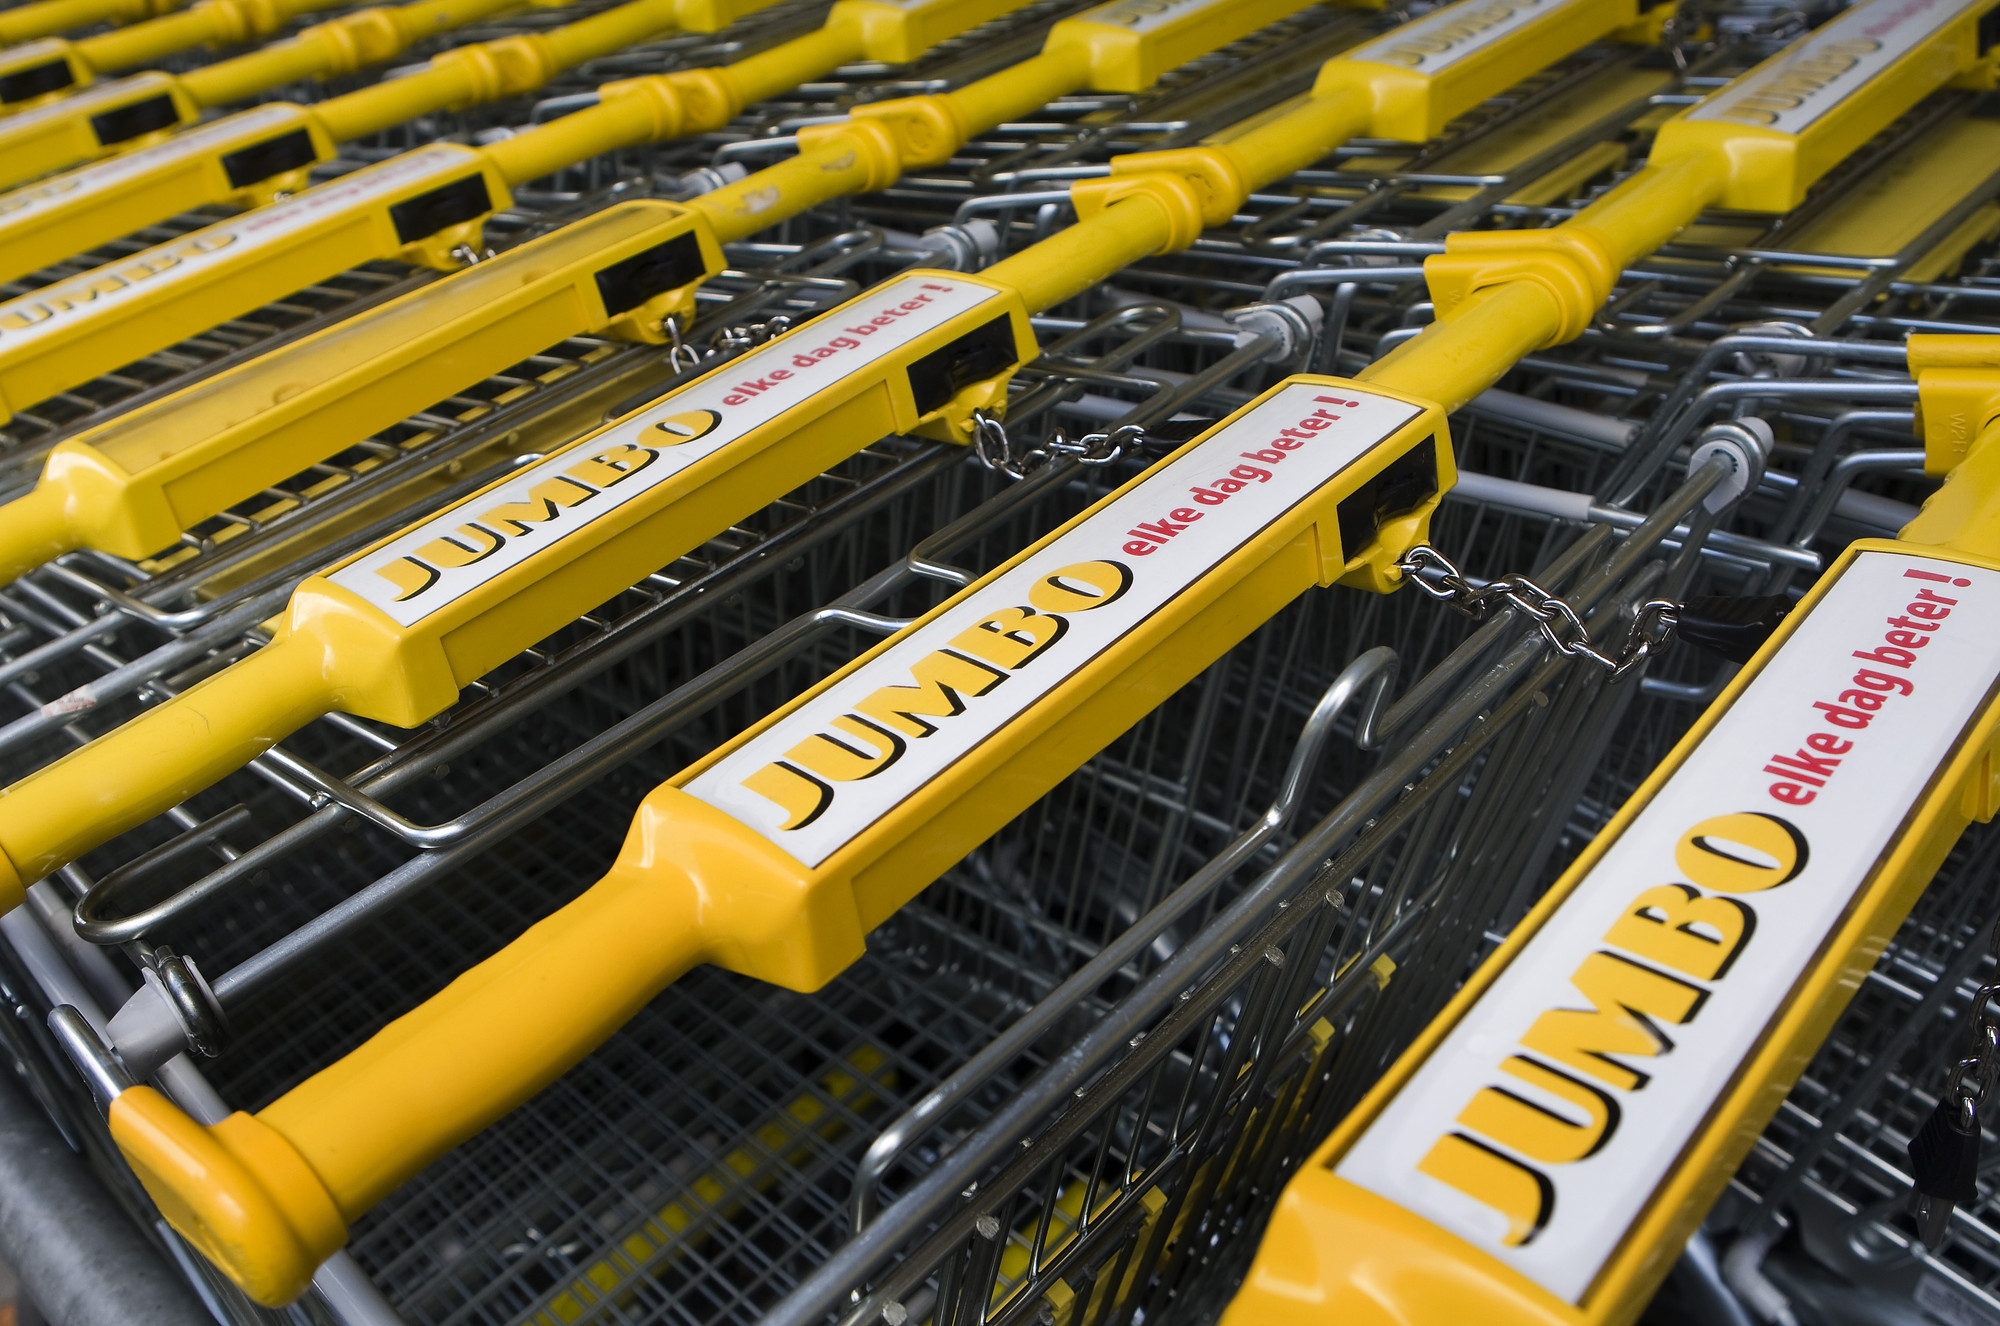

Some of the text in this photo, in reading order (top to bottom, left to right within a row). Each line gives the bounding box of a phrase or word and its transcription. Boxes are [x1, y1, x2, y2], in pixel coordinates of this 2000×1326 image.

[0, 234, 238, 336] UMBO
[374, 408, 722, 602] JUMBO
[722, 369, 795, 406] elke
[791, 337, 861, 368] dag
[739, 559, 1134, 831] JUMBO
[1121, 507, 1205, 557] elke
[1189, 463, 1273, 506] dag
[1415, 811, 1810, 1248] JUMBO
[1762, 732, 1854, 806] elke
[1812, 668, 1914, 730] dag
